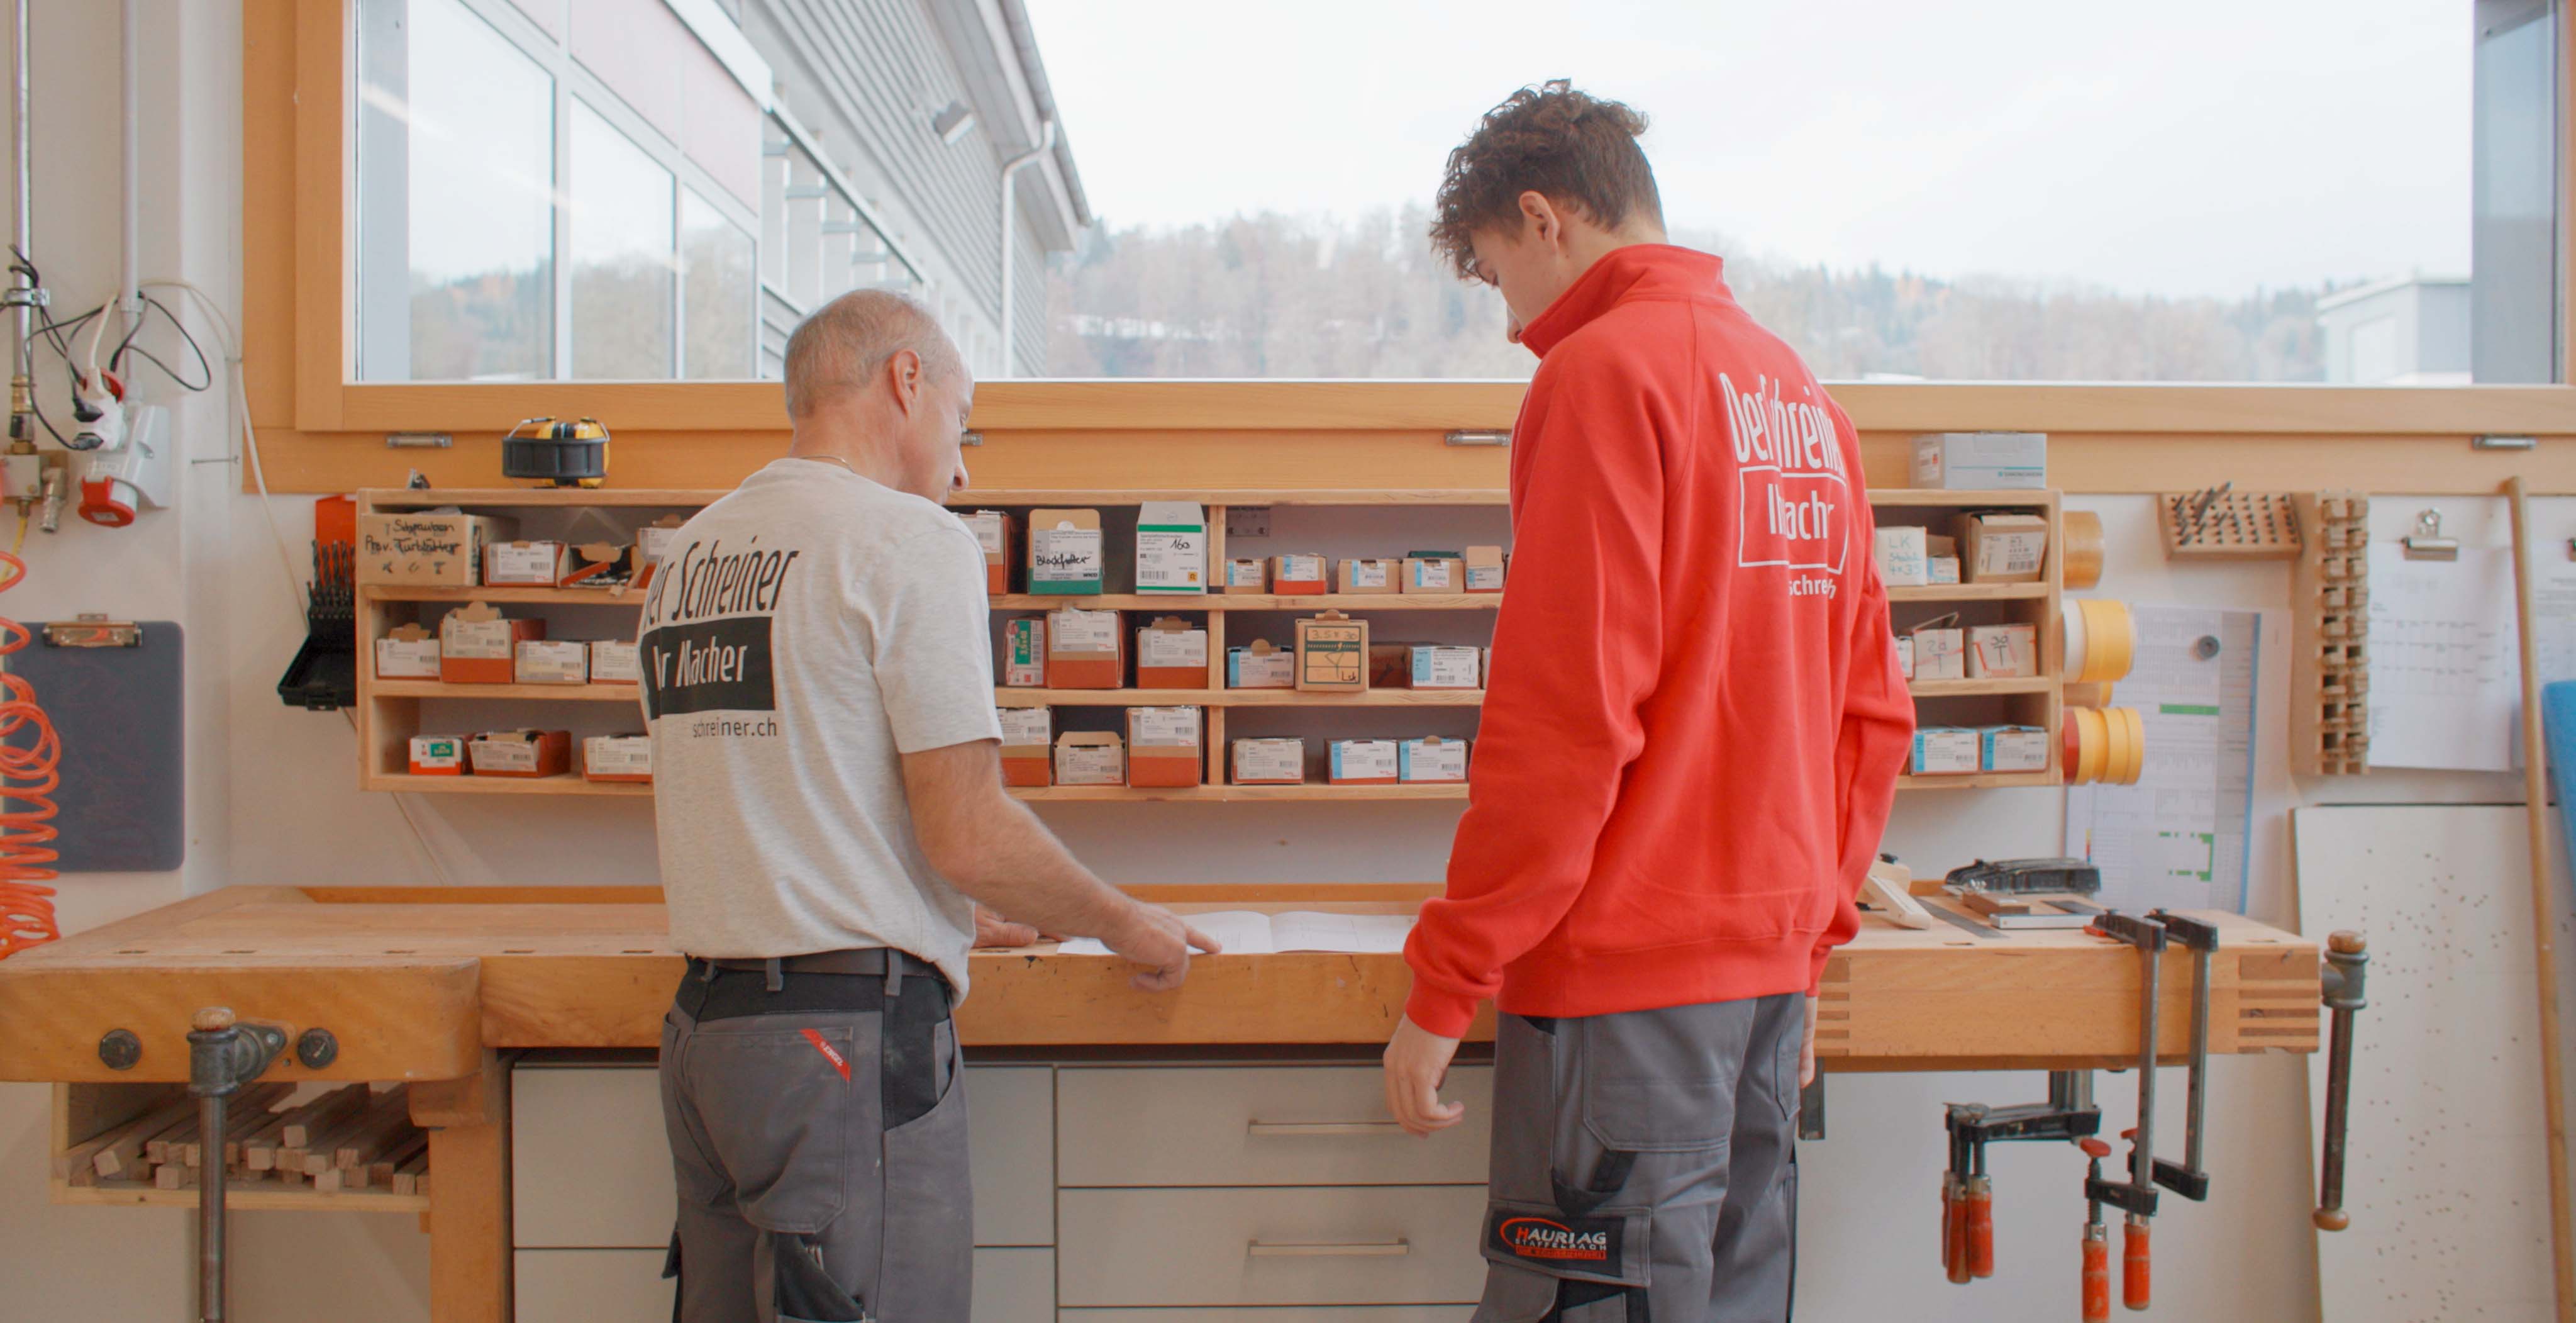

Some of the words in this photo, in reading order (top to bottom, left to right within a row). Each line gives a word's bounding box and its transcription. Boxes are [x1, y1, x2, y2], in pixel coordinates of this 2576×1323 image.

[671, 535, 800, 621] Schreiner
[692, 716, 777, 739] schreiner.ch
[1576, 1231, 1607, 1245] AG
